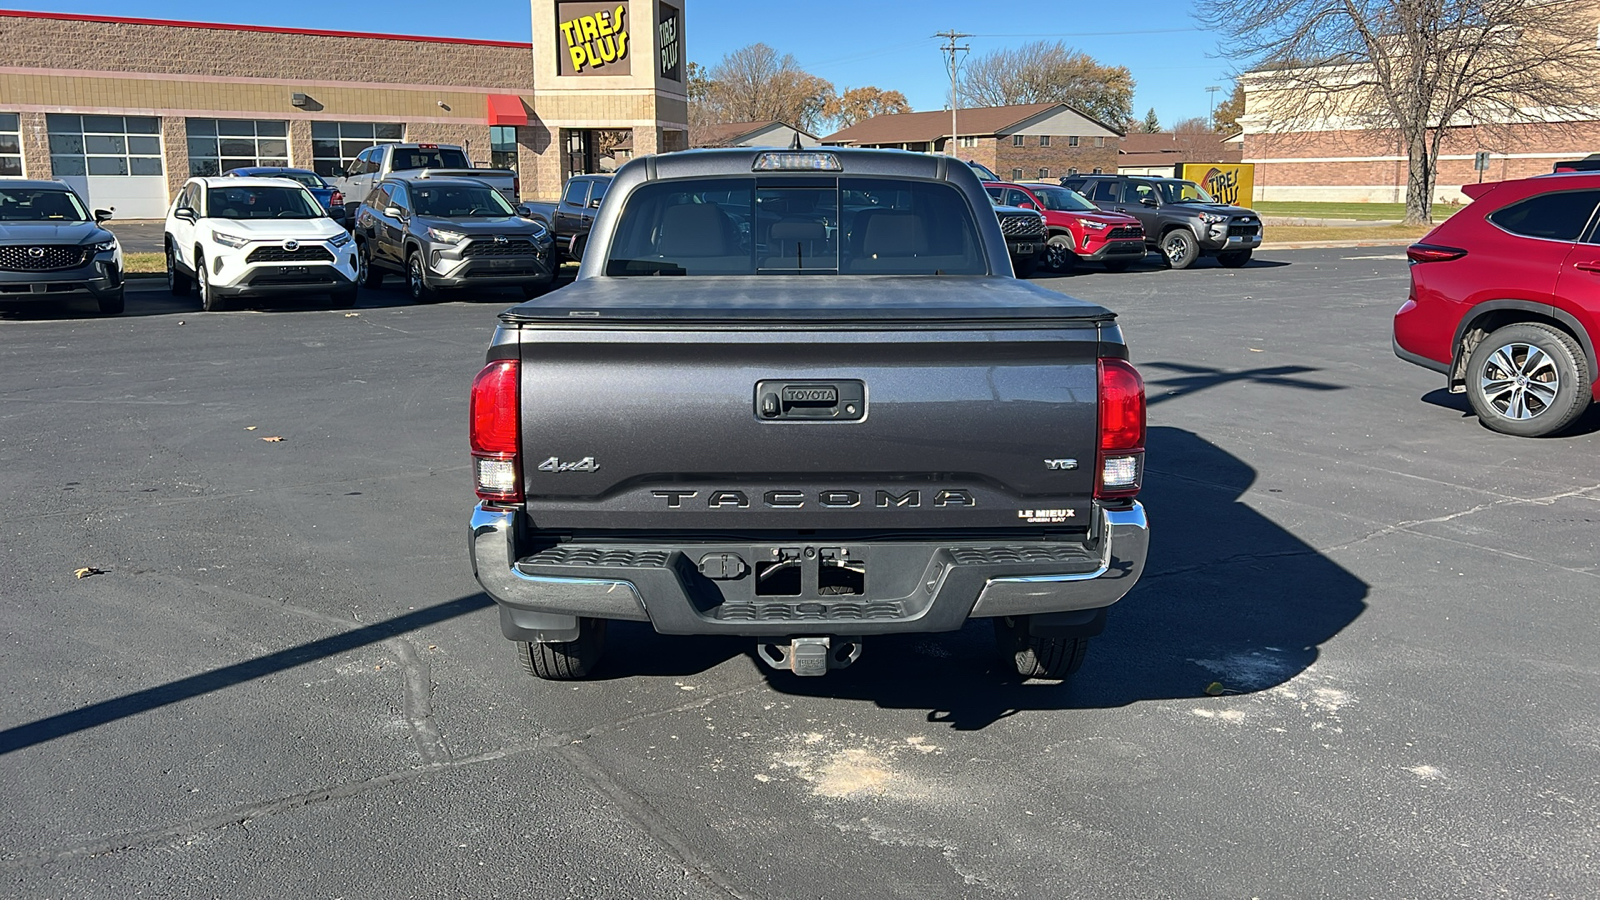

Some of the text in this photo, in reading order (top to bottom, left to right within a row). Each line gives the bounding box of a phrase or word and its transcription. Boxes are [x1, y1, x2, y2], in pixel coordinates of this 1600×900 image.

[559, 5, 626, 48] TIRES
[659, 17, 676, 48] TIRES
[569, 30, 630, 73] PLUS
[662, 42, 678, 73] PLUS
[1209, 168, 1239, 195] TIRES
[1212, 186, 1239, 204] PLUS
[788, 391, 834, 400] TOYOTA
[538, 456, 601, 473] 4x4
[1044, 459, 1077, 469] V6
[651, 489, 976, 508] TACOMA
[1018, 509, 1075, 518] LE MIEUX
